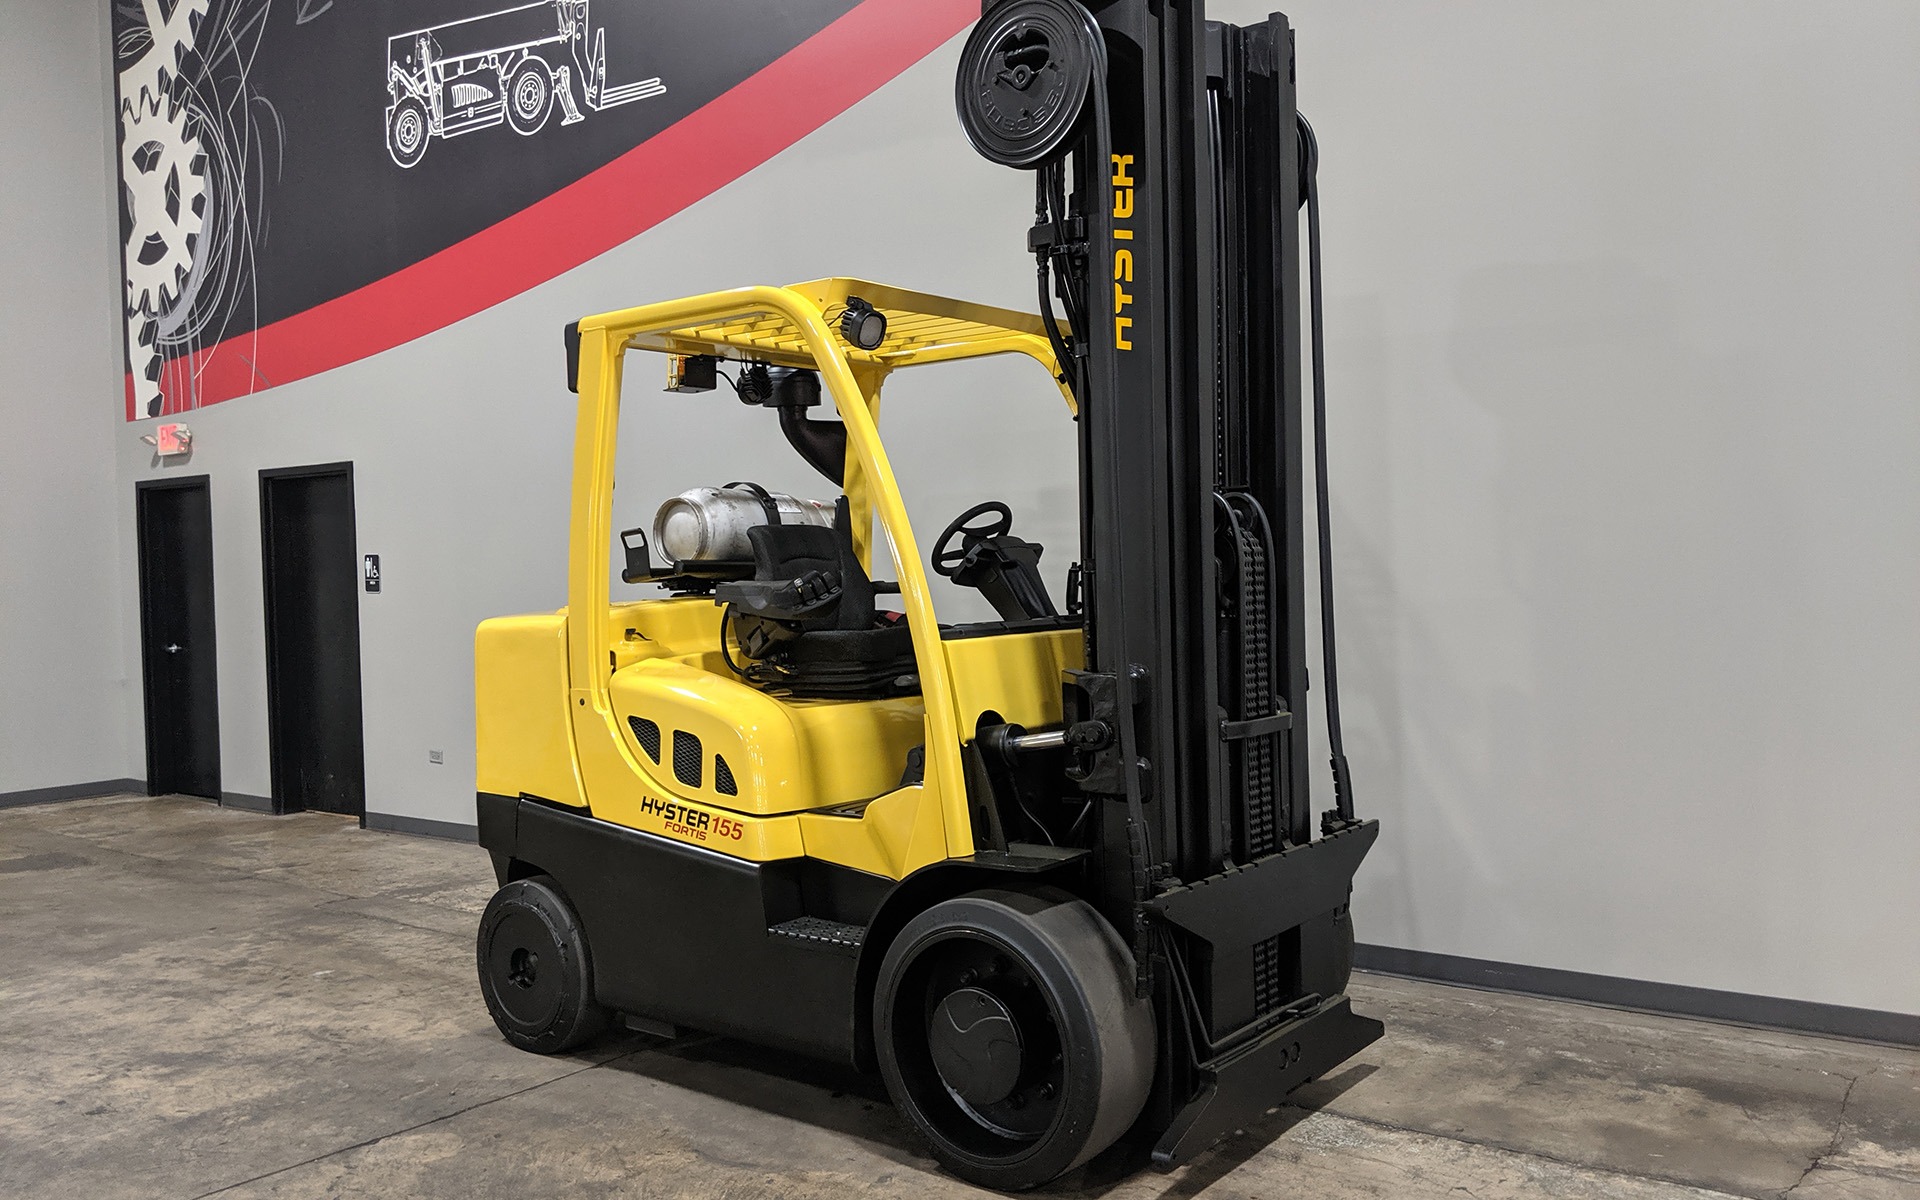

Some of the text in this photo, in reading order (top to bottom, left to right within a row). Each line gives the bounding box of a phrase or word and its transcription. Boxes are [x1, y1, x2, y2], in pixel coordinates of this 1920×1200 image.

[642, 796, 743, 840] HYSTER 155
[665, 822, 707, 841] FORTIS
